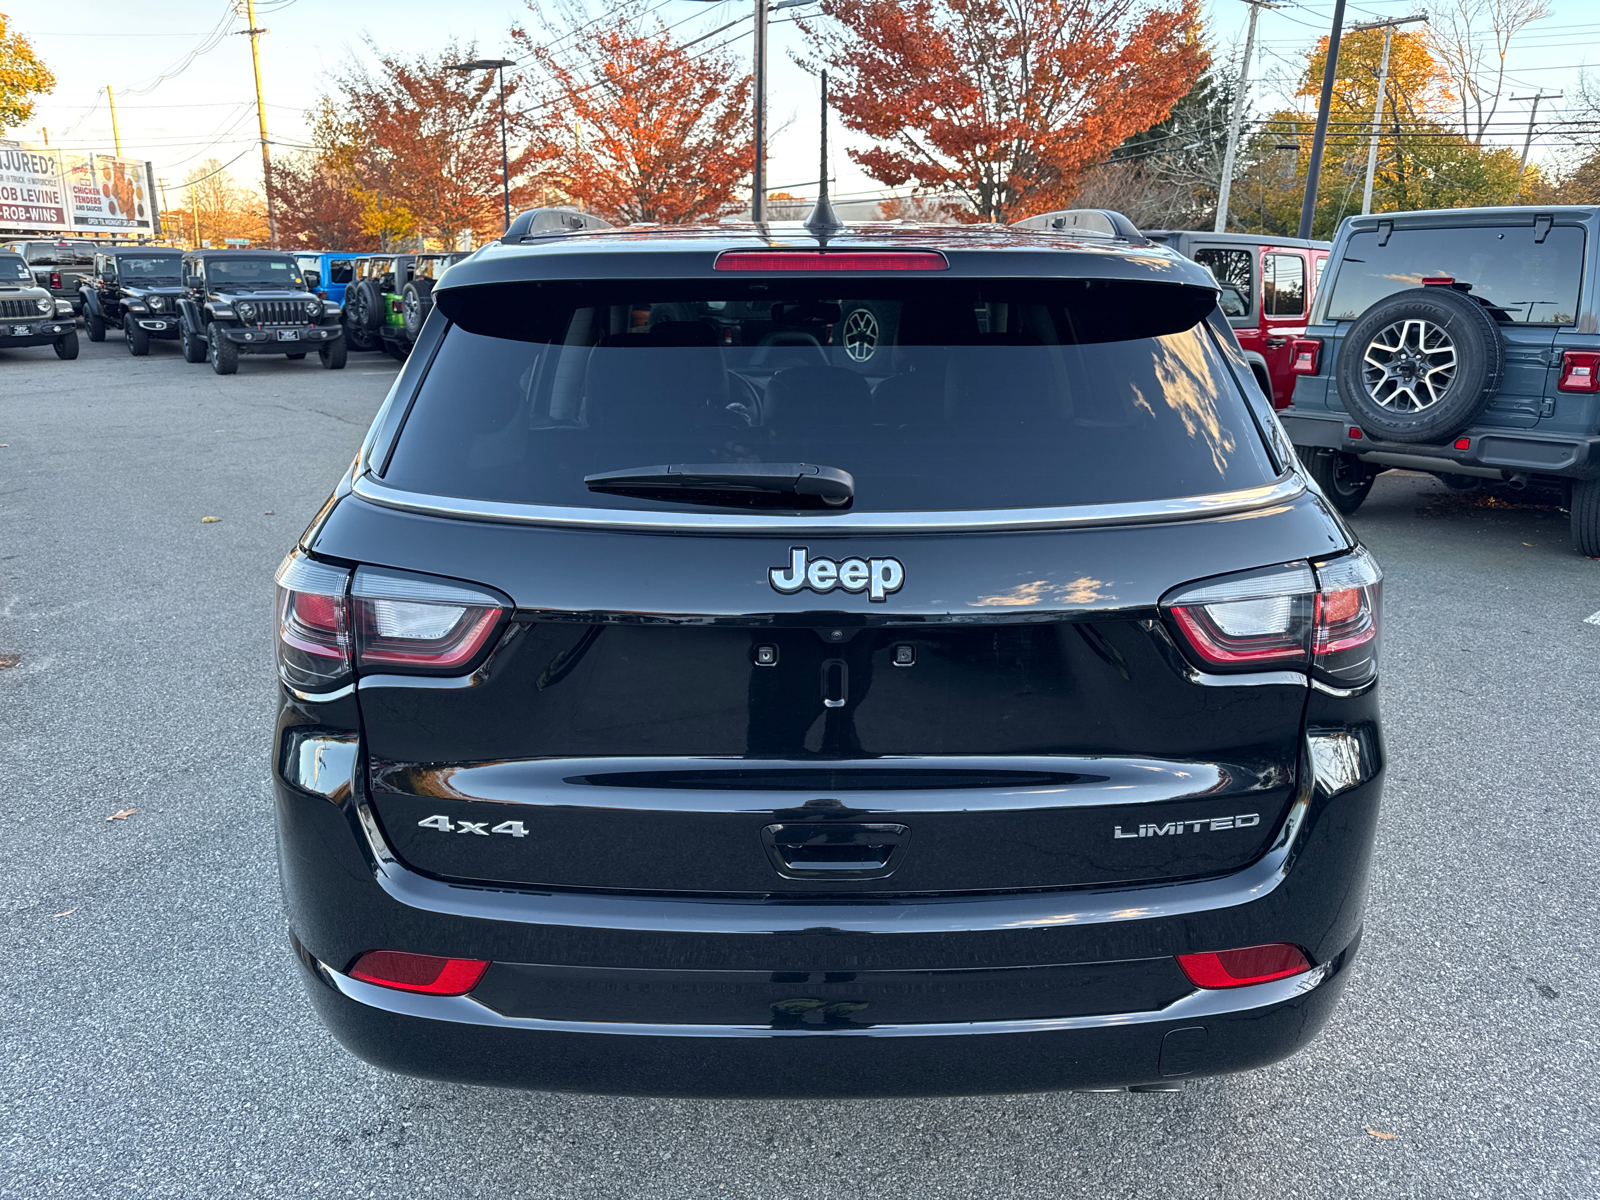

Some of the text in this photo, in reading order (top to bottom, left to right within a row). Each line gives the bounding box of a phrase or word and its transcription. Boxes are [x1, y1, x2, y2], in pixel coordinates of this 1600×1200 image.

[0, 186, 59, 204] OB LEVINE
[72, 186, 100, 195] CHICKEN
[74, 195, 101, 205] TENDERS
[769, 547, 905, 601] Jeep
[418, 815, 530, 837] 4x4
[1114, 813, 1260, 839] LIMITED
